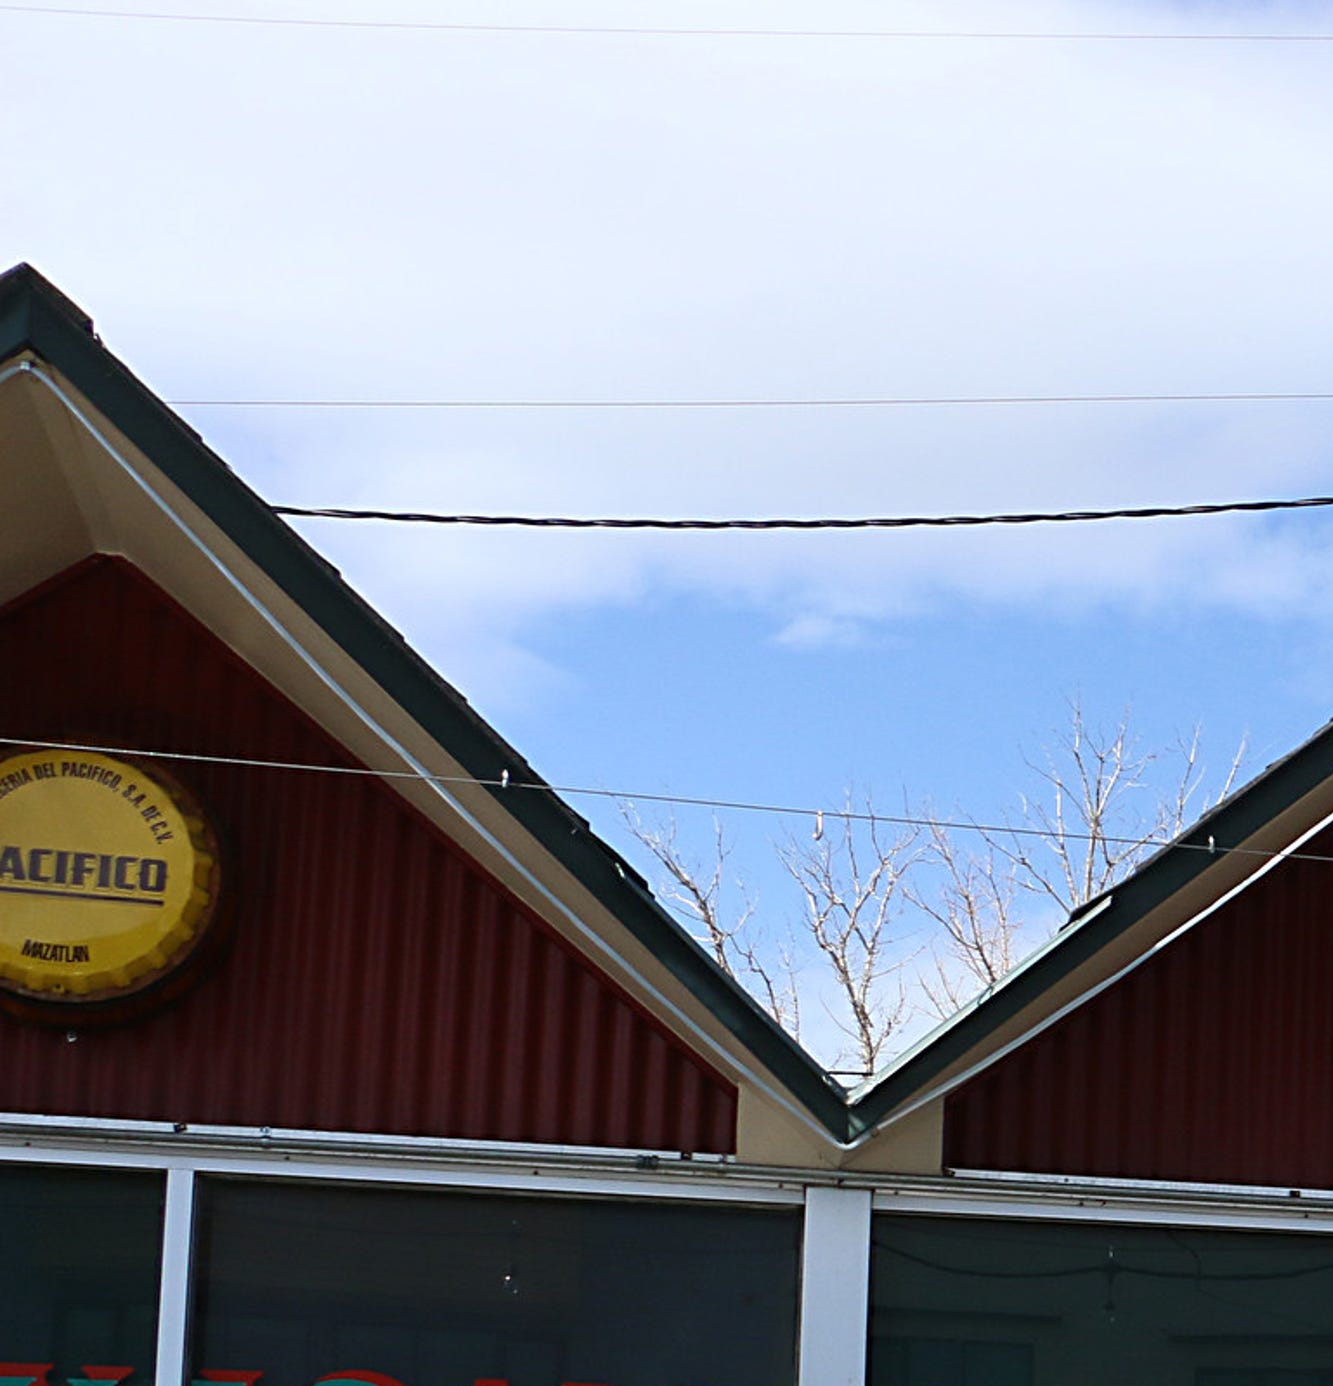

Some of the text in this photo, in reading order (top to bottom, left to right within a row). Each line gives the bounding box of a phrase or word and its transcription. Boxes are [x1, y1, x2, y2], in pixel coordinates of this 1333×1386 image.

[34, 763, 56, 779] DEL
[62, 763, 121, 792] PACIFICO,
[123, 785, 145, 809] S.A.
[142, 806, 160, 822] DE
[21, 939, 91, 963] MAZATLAN
